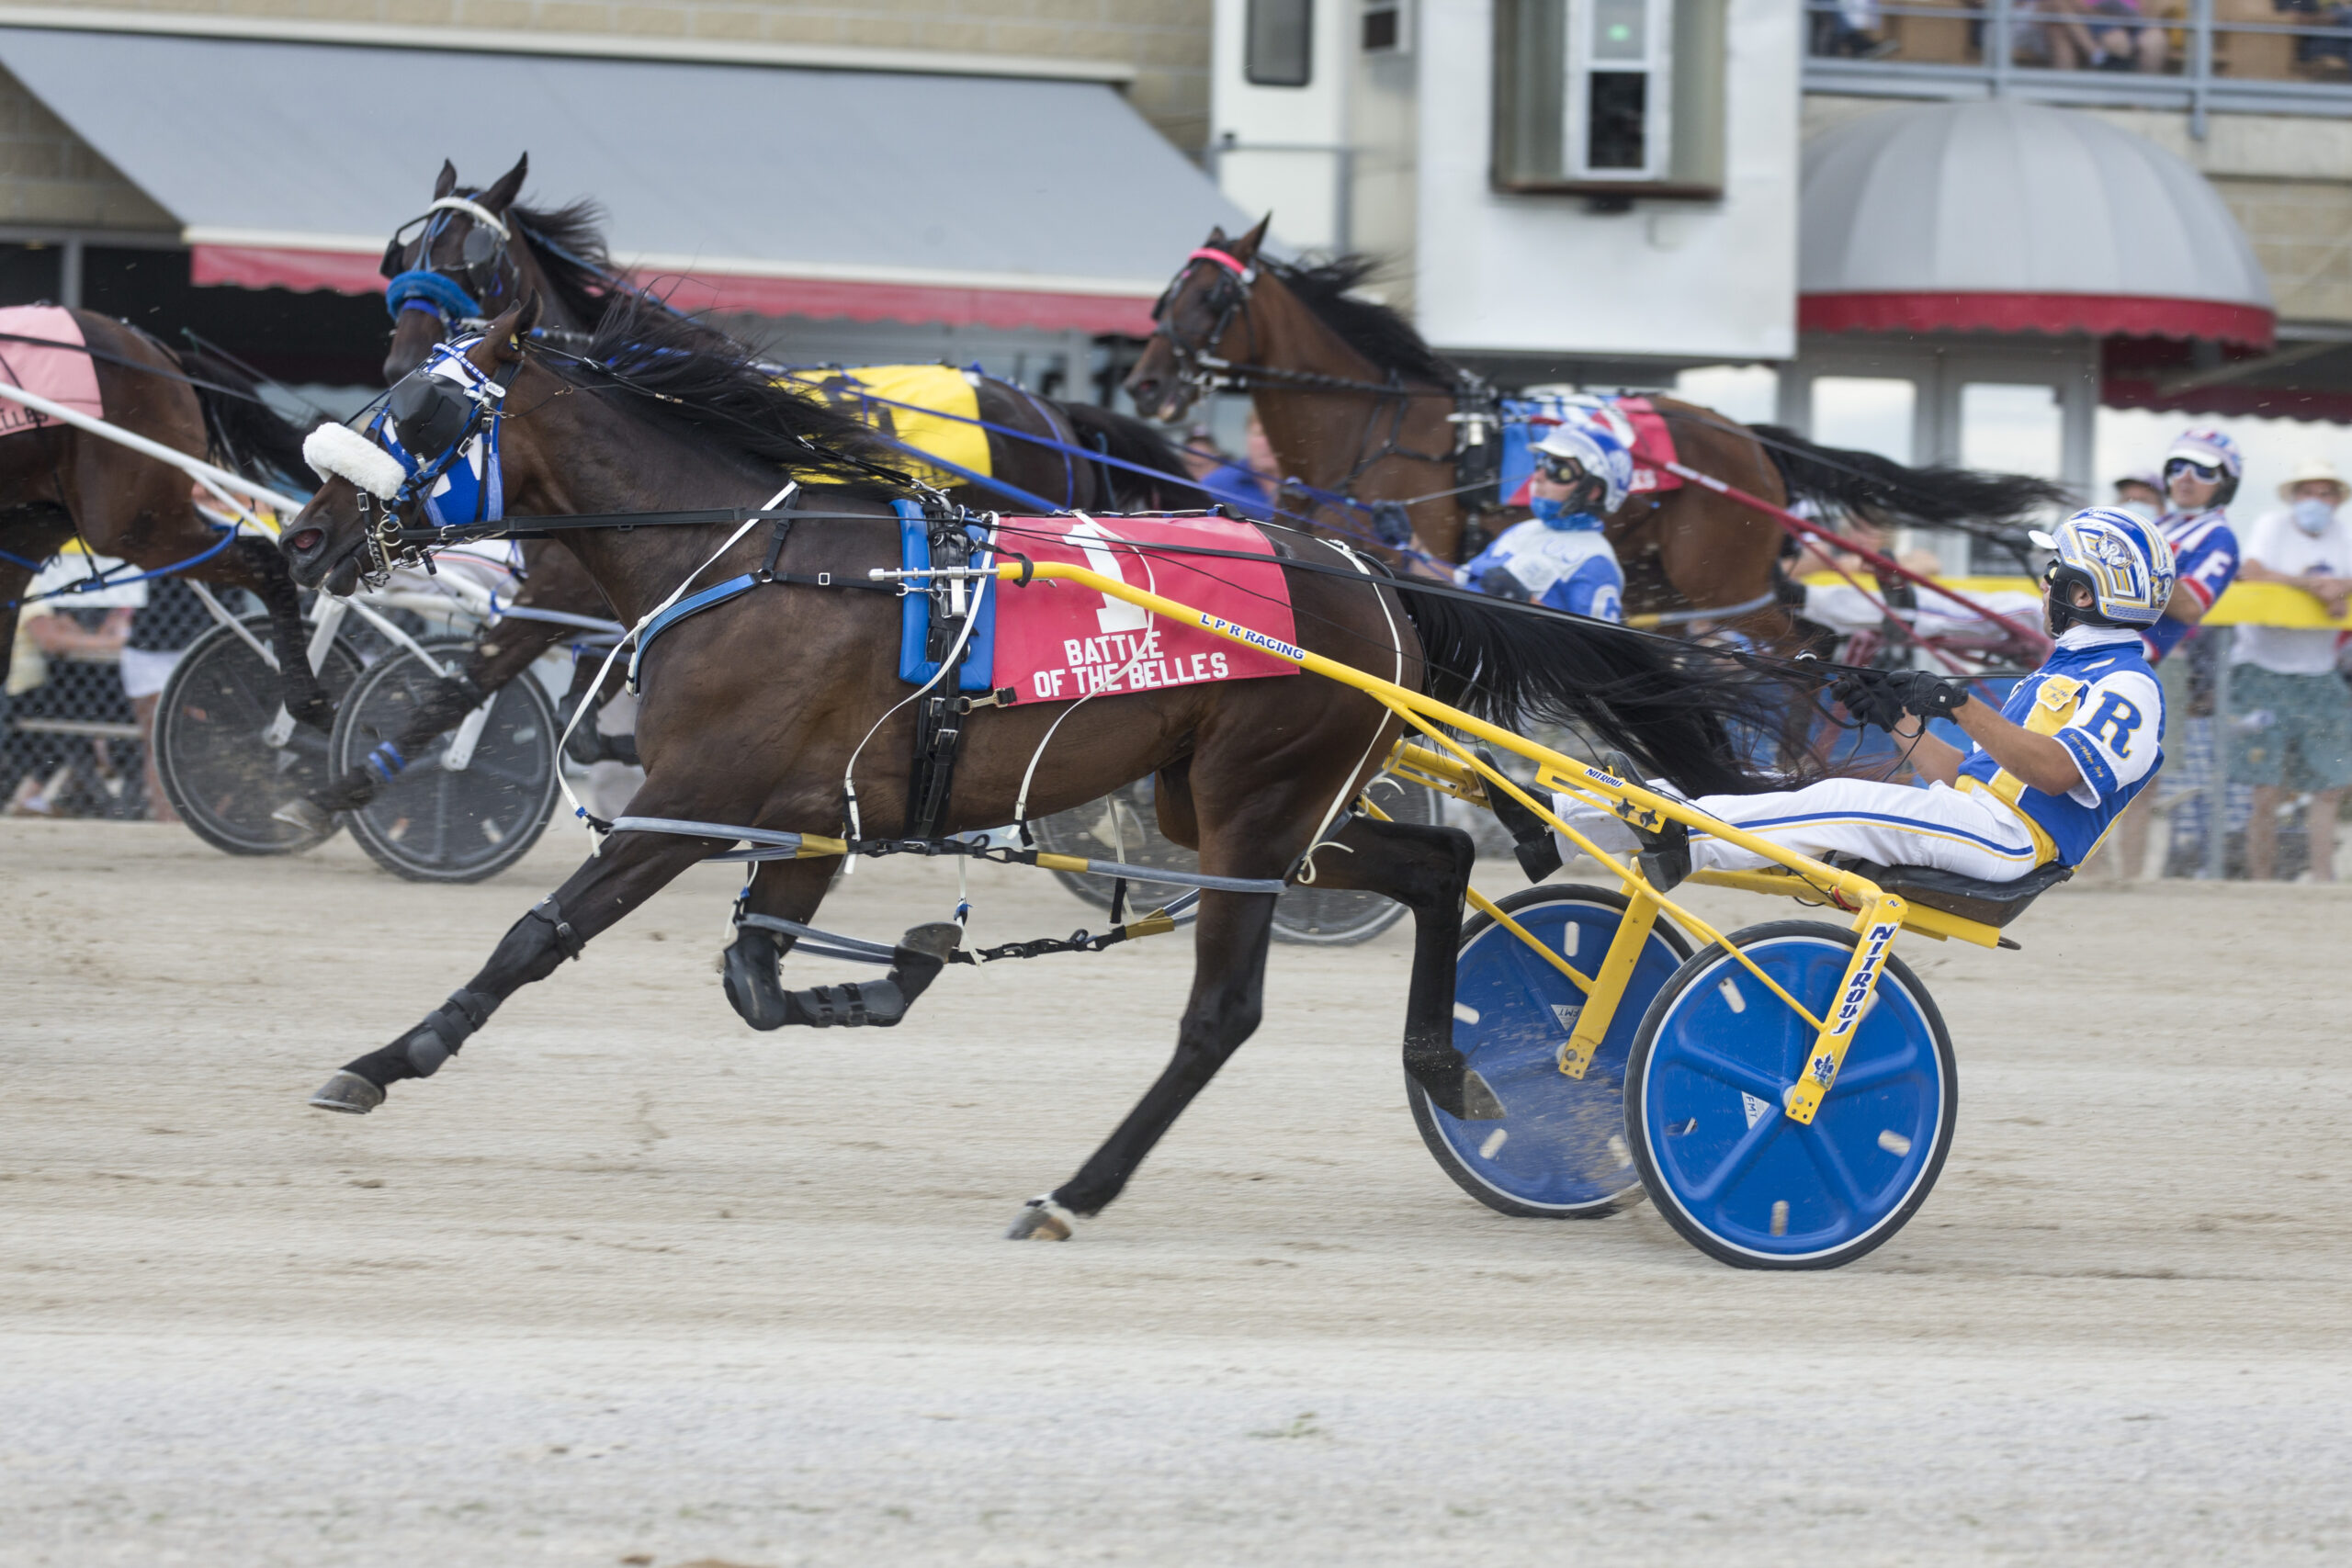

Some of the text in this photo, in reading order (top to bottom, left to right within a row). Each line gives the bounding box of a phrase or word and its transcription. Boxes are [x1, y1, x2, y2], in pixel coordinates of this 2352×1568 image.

[1064, 631, 1165, 667] BATTLE
[1201, 614, 1306, 660] L P R RACING
[1034, 652, 1229, 698] OF THE BELLES
[2079, 688, 2143, 761] R
[1585, 768, 1624, 788] NITROUS
[1831, 925, 1897, 1035] NITROUS
[1746, 1096, 1758, 1119] FMT
